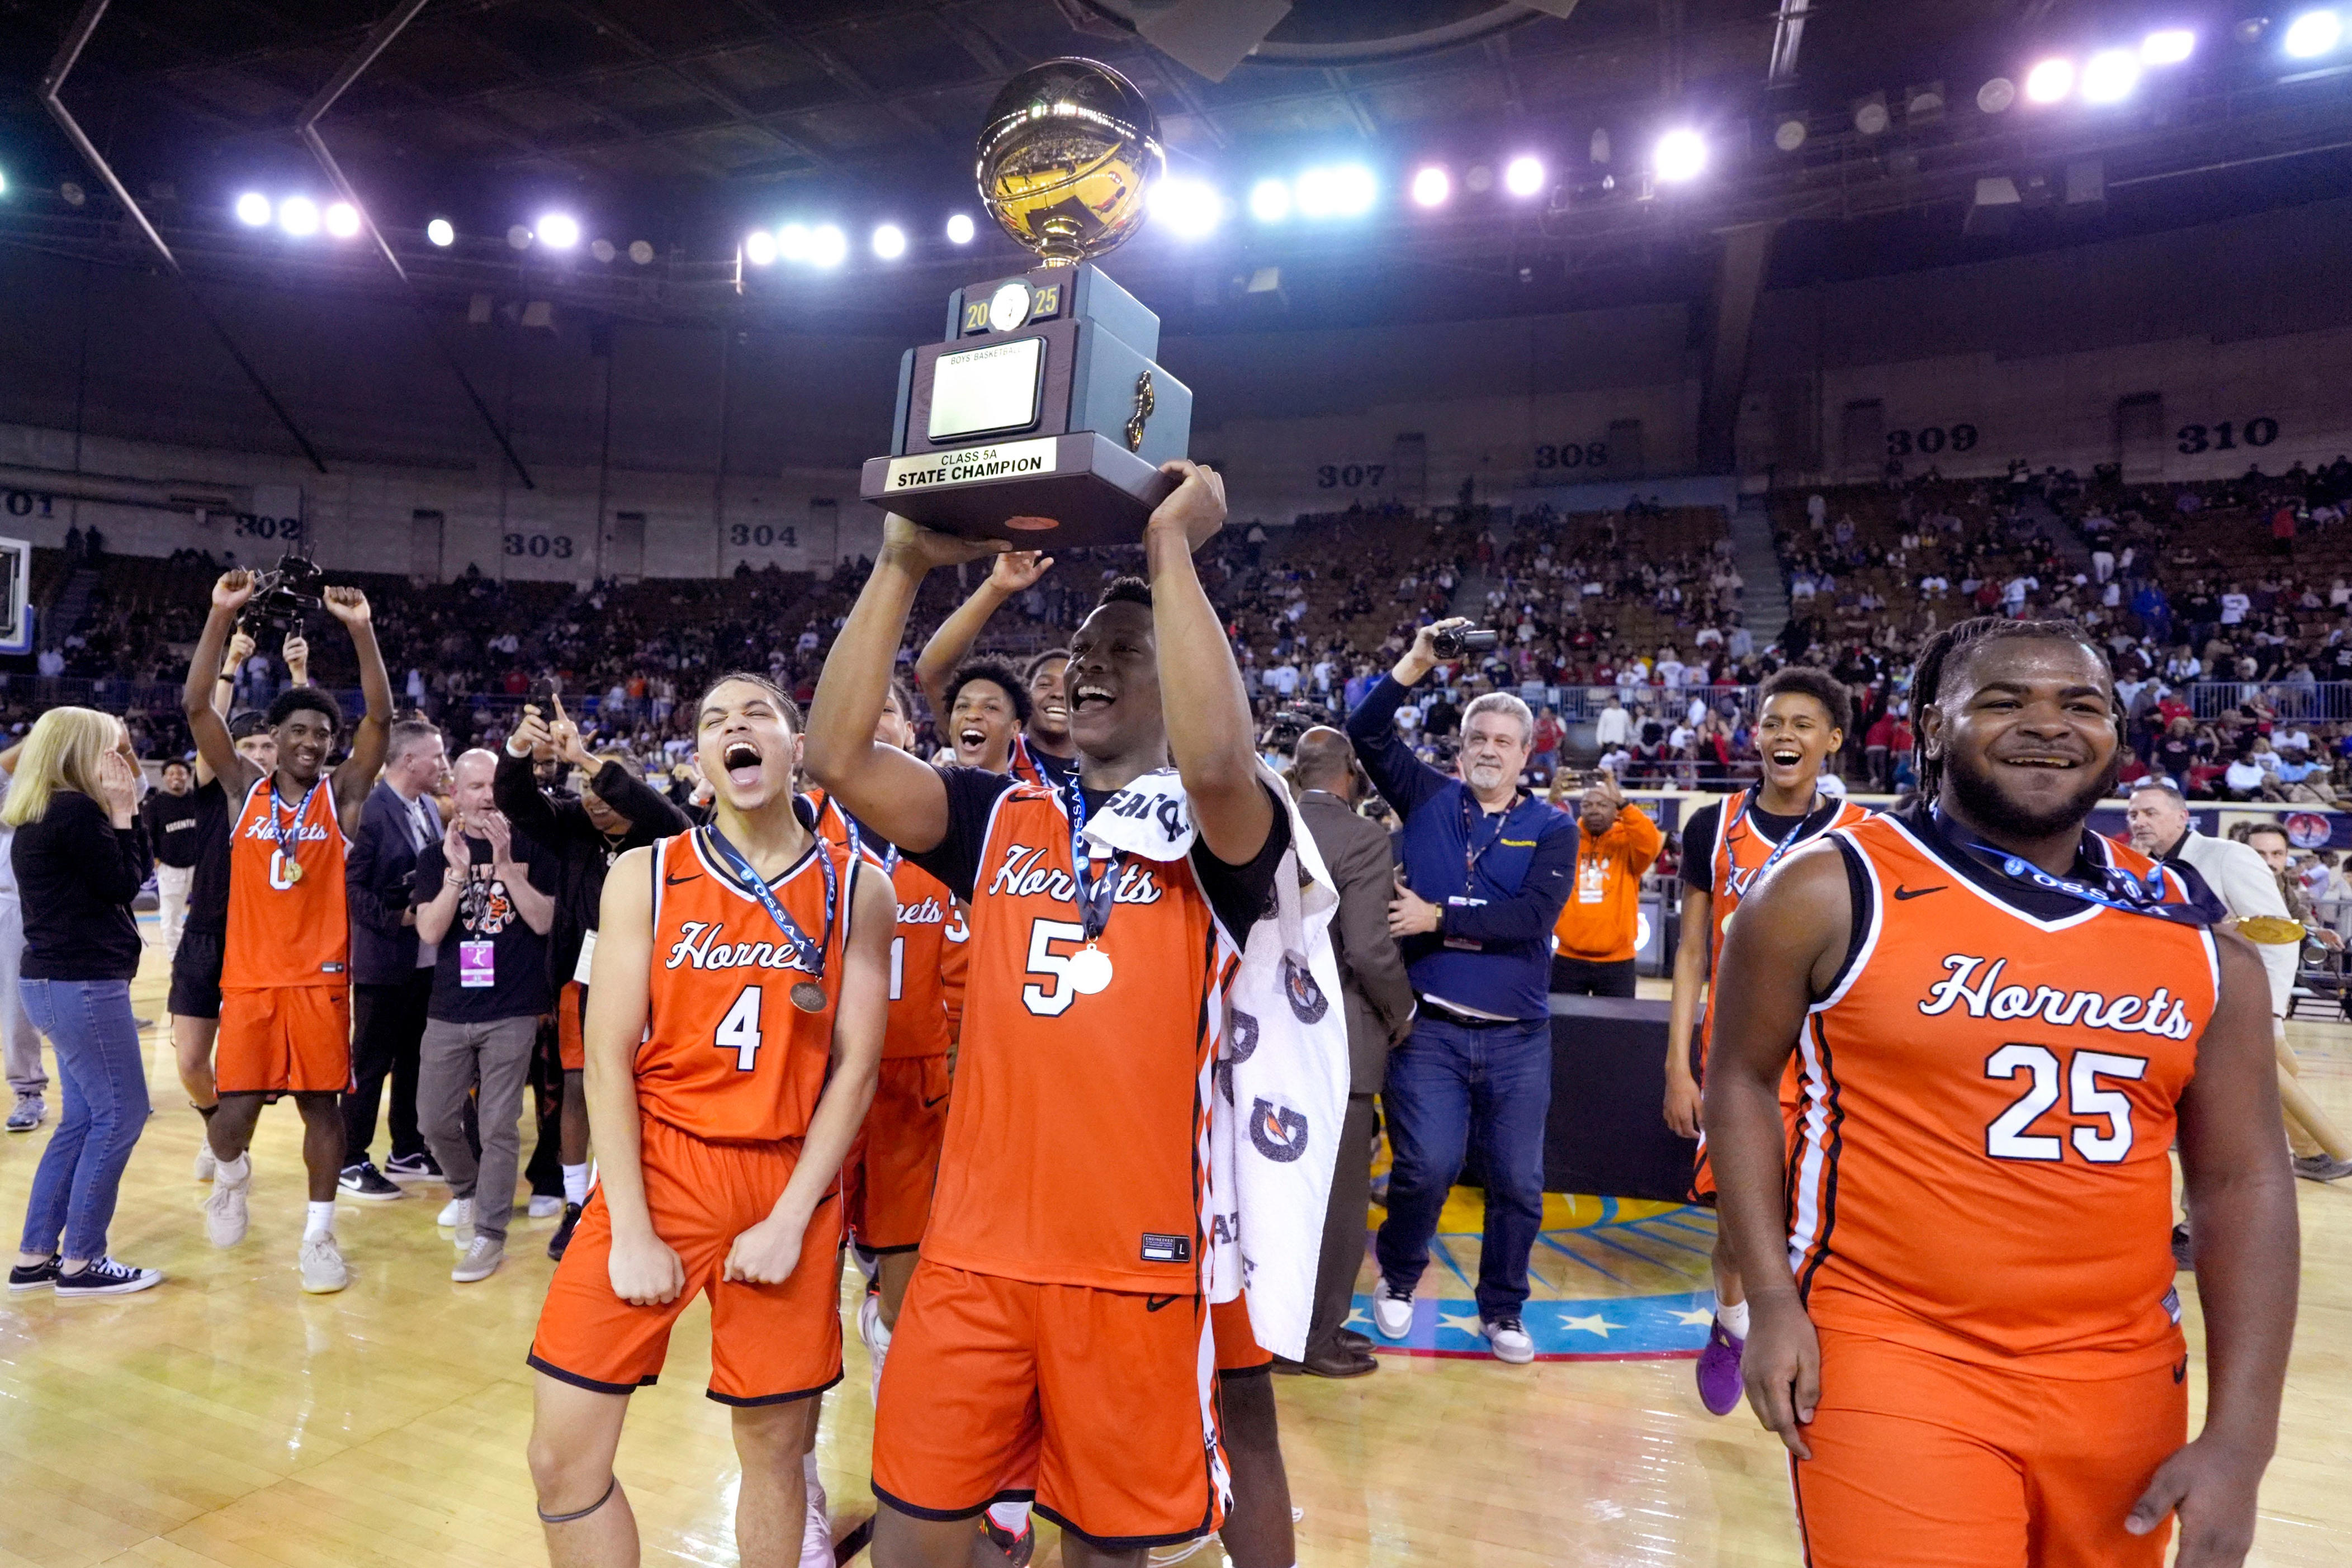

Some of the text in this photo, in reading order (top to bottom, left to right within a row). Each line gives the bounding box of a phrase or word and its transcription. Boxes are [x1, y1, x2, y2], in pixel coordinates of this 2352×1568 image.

[967, 287, 1057, 328] 20 25
[1886, 423, 1979, 456] 309
[2178, 417, 2279, 454] 310
[941, 449, 997, 466] CLASS 5A
[1535, 441, 1608, 469] 308
[898, 457, 1042, 487] STATE CHAMPION
[1317, 463, 1386, 489] 307
[0, 490, 54, 518] 01
[235, 514, 299, 540] 302
[730, 524, 798, 547] 304
[504, 533, 573, 558] 303
[1069, 776, 1084, 848] OSSAA
[754, 884, 806, 953] OSSAA
[665, 921, 826, 975] Horne
[1022, 917, 1086, 1017] 5
[1919, 953, 2193, 1040] Hornets
[713, 984, 763, 1072] 4
[1984, 1042, 2149, 1163] 25
[1179, 1243, 1185, 1254] L
